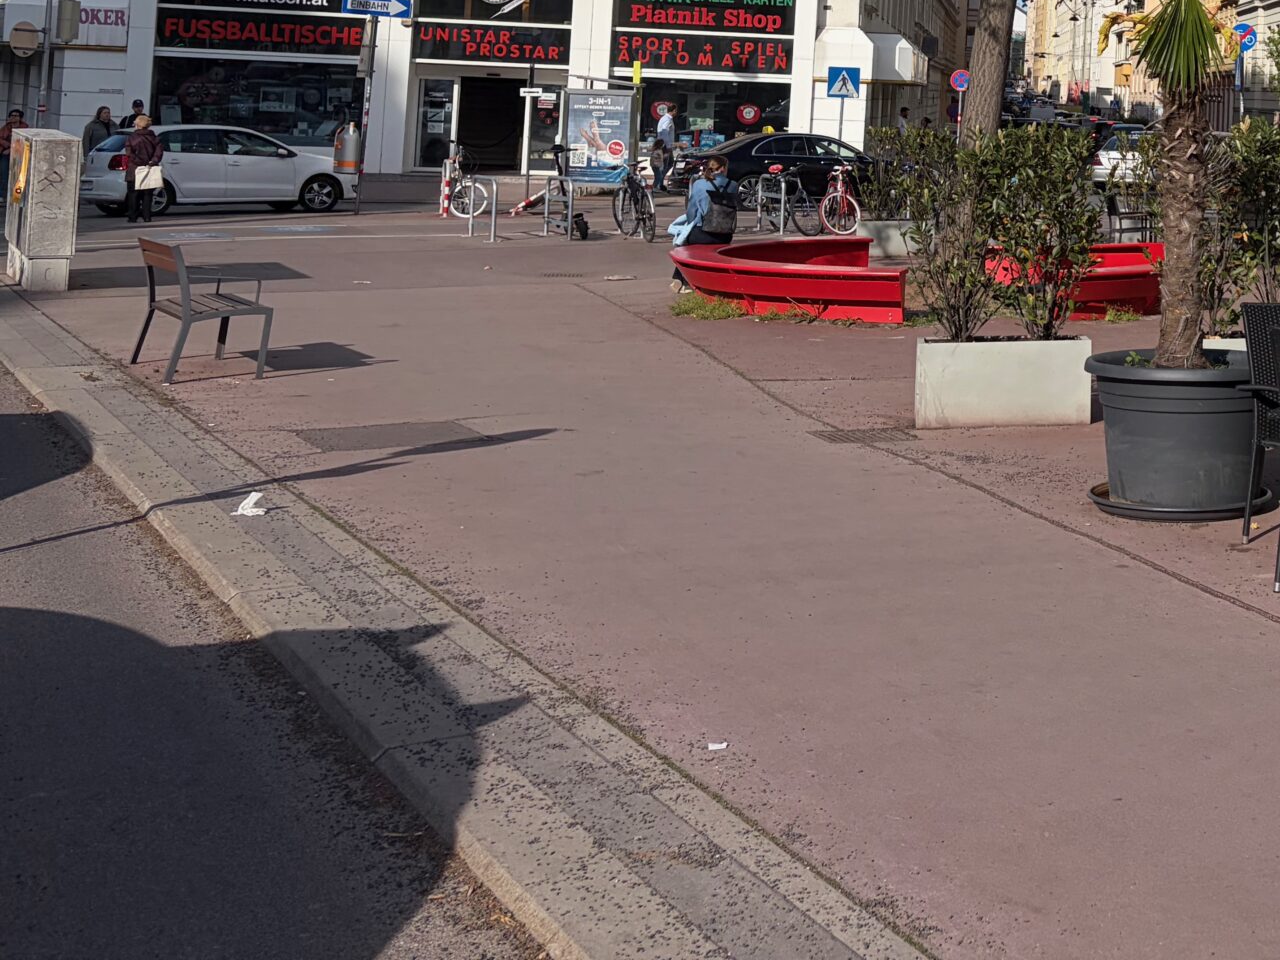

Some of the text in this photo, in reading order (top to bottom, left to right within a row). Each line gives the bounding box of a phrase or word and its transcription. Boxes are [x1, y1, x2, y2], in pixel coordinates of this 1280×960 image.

[351, 0, 389, 11] EINBAHN
[630, 4, 782, 32] Piatnik Shop
[165, 18, 362, 45] FUSSBALLTISCHE
[420, 27, 511, 44] UNISTAR
[465, 43, 559, 60] PROSTAR
[618, 36, 685, 52] SPORT
[731, 41, 787, 57] SPIEL
[618, 50, 787, 70] AUTOMATEN
